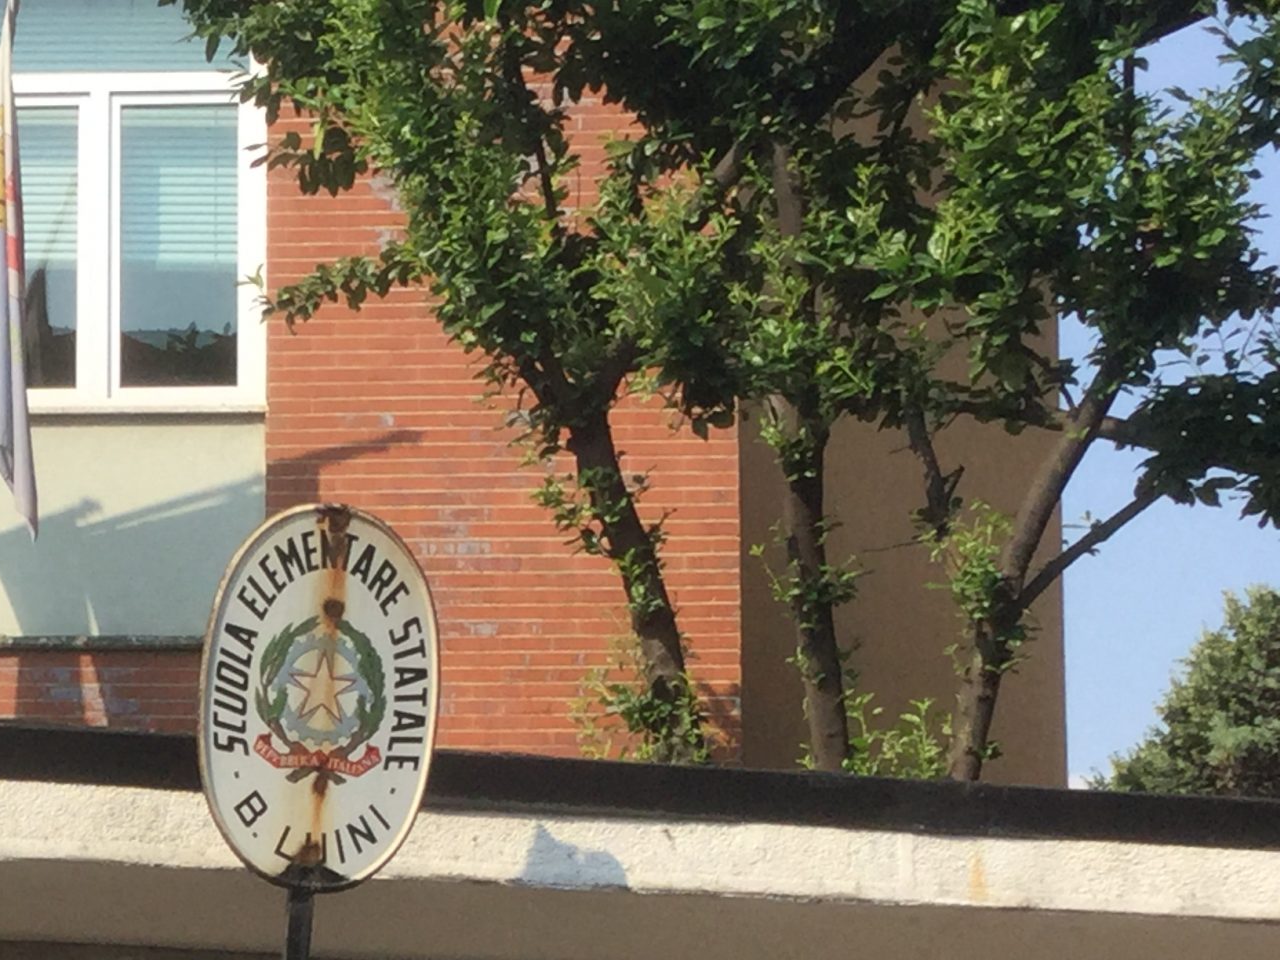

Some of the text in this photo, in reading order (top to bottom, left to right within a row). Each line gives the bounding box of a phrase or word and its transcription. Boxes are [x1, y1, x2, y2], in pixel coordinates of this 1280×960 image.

[213, 528, 428, 772] SCUOLA ELEMENTARE STATALE
[234, 789, 392, 865] B. LUINI
